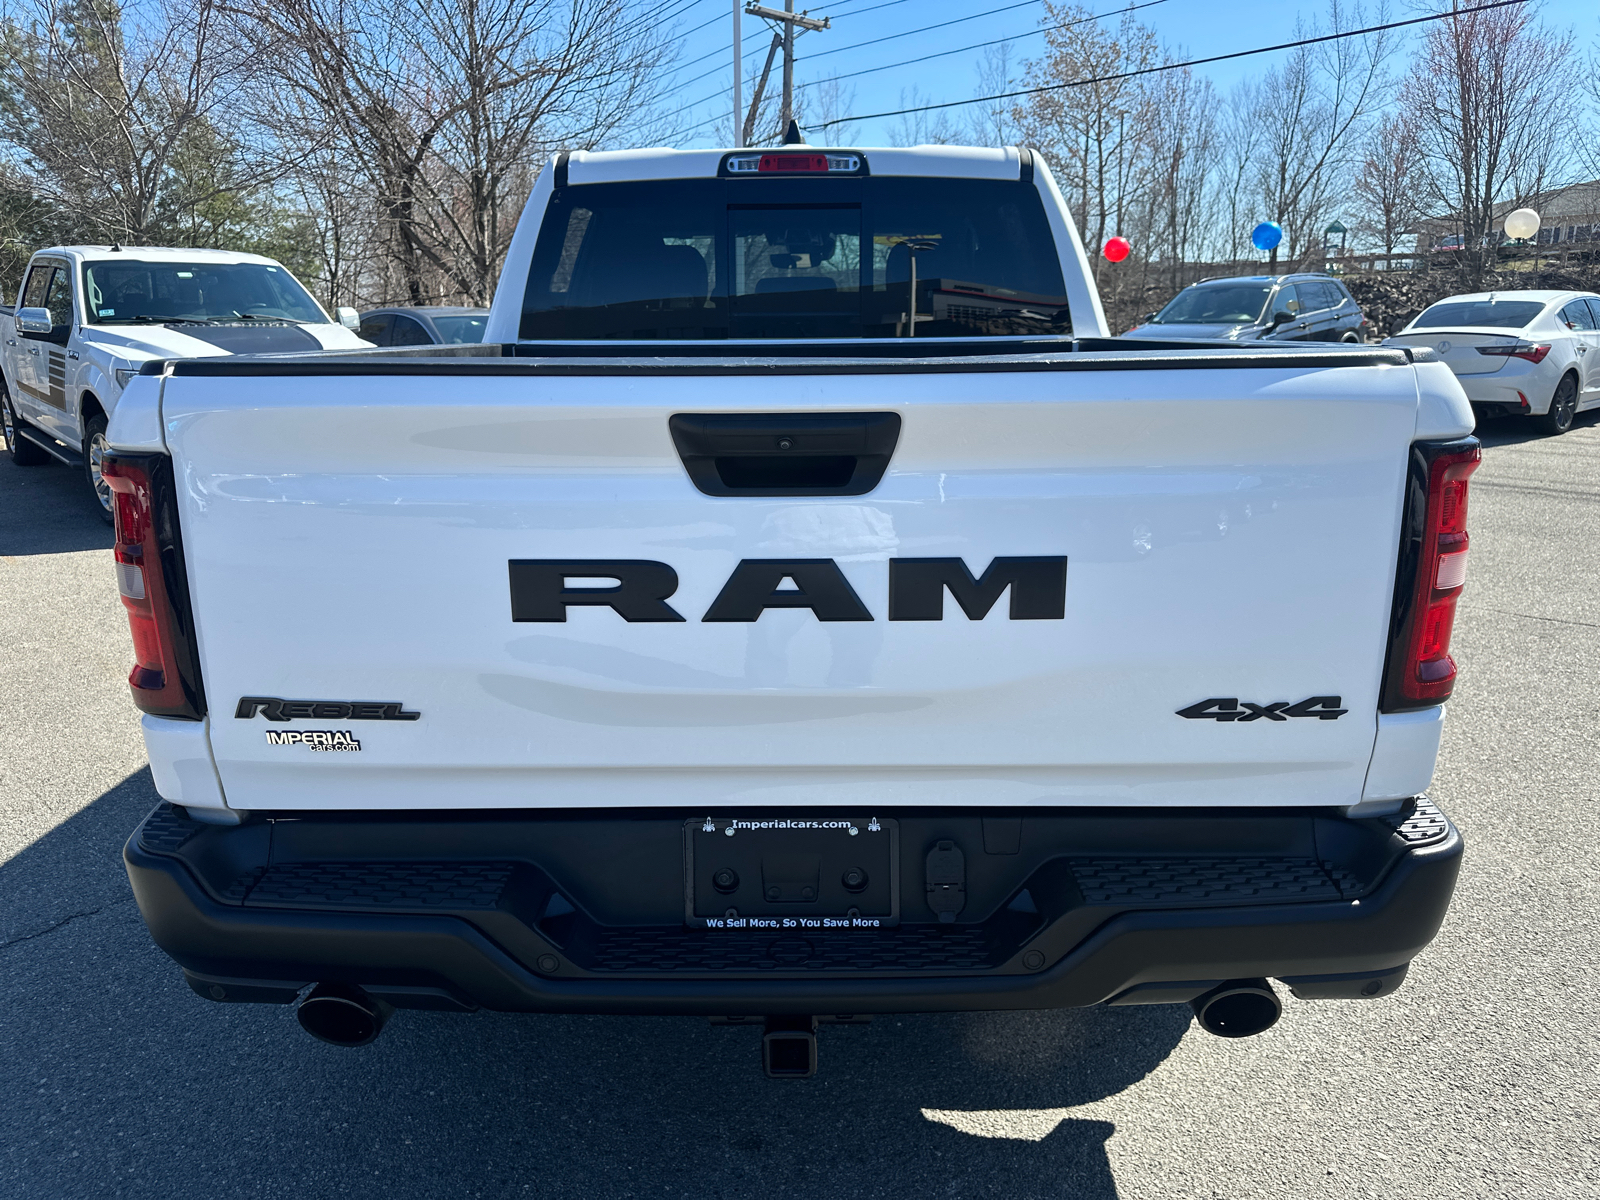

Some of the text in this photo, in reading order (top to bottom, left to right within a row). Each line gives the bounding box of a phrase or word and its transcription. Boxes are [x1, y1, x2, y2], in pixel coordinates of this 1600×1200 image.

[508, 555, 1067, 622] RAM
[235, 696, 421, 722] REBEL
[266, 730, 359, 745] IMPERIAL
[309, 743, 360, 752] cars.com
[732, 819, 851, 830] Imperialcars.com
[706, 918, 880, 929] We Sell More, So You Save More
